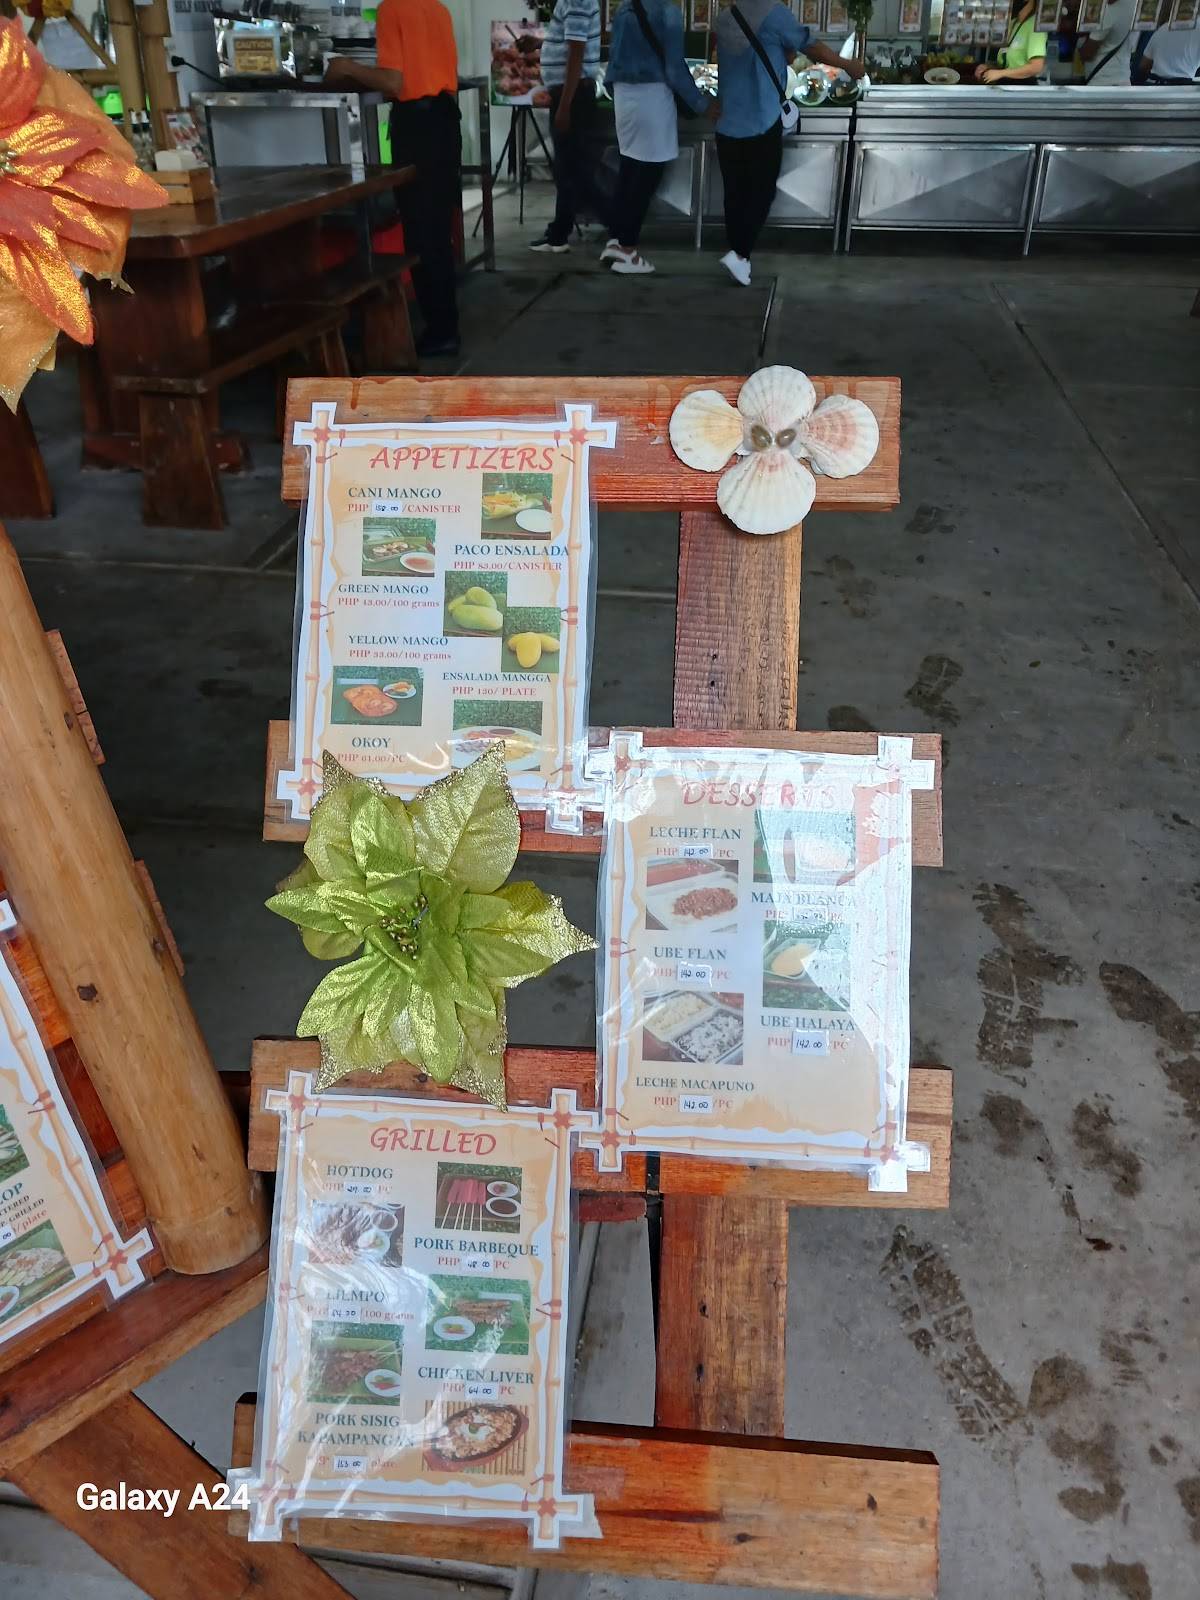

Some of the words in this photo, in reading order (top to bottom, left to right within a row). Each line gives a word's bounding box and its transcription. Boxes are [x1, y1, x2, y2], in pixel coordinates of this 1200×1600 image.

[369, 446, 556, 471] APPETIZERS
[348, 487, 382, 498] CANI
[387, 487, 442, 499] MANGO
[347, 503, 369, 512] PHP
[455, 544, 491, 555] PACO
[495, 544, 569, 556] ENSALADA
[454, 561, 475, 569] PHP
[338, 583, 380, 593] GREEN
[383, 585, 429, 594] MANGO
[337, 597, 359, 606] PHP
[411, 601, 440, 609] grams
[348, 635, 400, 645] YELLOW
[402, 636, 449, 646] MANGO
[349, 649, 371, 658] PHP
[423, 653, 451, 662] grams
[442, 672, 499, 682] ENSALADA
[501, 673, 552, 683] MANGGA
[452, 686, 474, 695] PHP
[502, 688, 537, 696] PLATE
[351, 736, 391, 748] OKOY
[337, 753, 359, 762] PHP
[650, 826, 699, 840] LECHE
[702, 827, 742, 841] FLAN
[656, 847, 678, 857] PHP
[654, 946, 684, 959] UBE
[688, 947, 728, 960] FLAN
[760, 1015, 790, 1028] UBE
[795, 1016, 856, 1031] HALAYA
[767, 1037, 791, 1047] PHP
[636, 1076, 677, 1089] LECHE
[680, 1078, 755, 1092] MACAPUNO
[654, 1096, 677, 1106] PHP
[370, 1126, 497, 1155] GRILLED
[326, 1164, 394, 1179] HOTDOG
[0, 1182, 23, 1205] OP
[0, 1195, 30, 1215] TERED
[414, 1237, 454, 1251] PORK
[459, 1239, 539, 1257] BARBEQUE
[438, 1256, 460, 1267] PHP
[418, 1366, 489, 1382] CHICKEN
[490, 1370, 535, 1384] LIVER
[315, 1413, 356, 1427] PORK
[360, 1414, 400, 1427] SISIG
